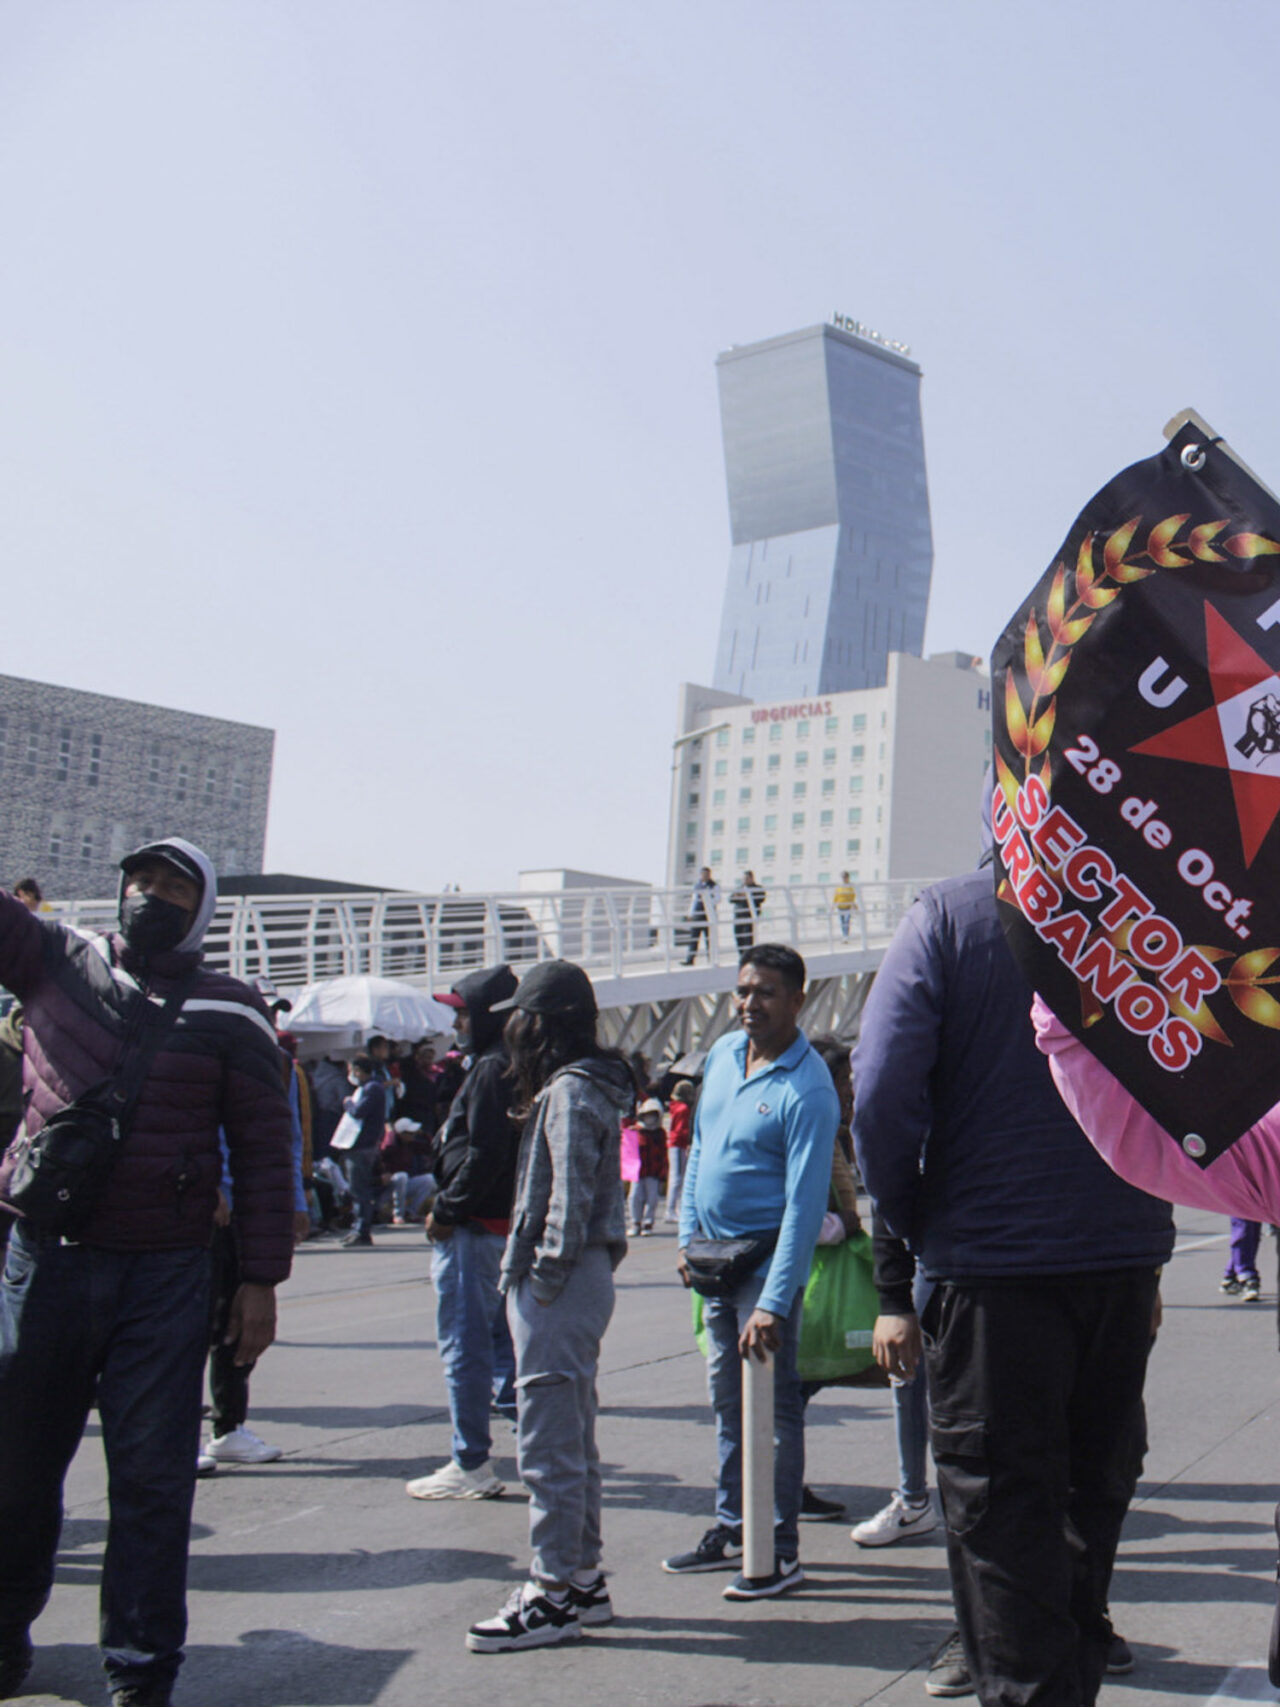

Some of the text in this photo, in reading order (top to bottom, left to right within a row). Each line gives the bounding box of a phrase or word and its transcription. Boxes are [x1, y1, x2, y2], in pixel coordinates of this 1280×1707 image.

[751, 700, 833, 724] URGENCIAS
[1137, 656, 1189, 709] U
[991, 782, 1203, 1073] URBANOS
[1016, 773, 1223, 1017] SECTOR
[1063, 734, 1254, 941] 28 de Oct.
